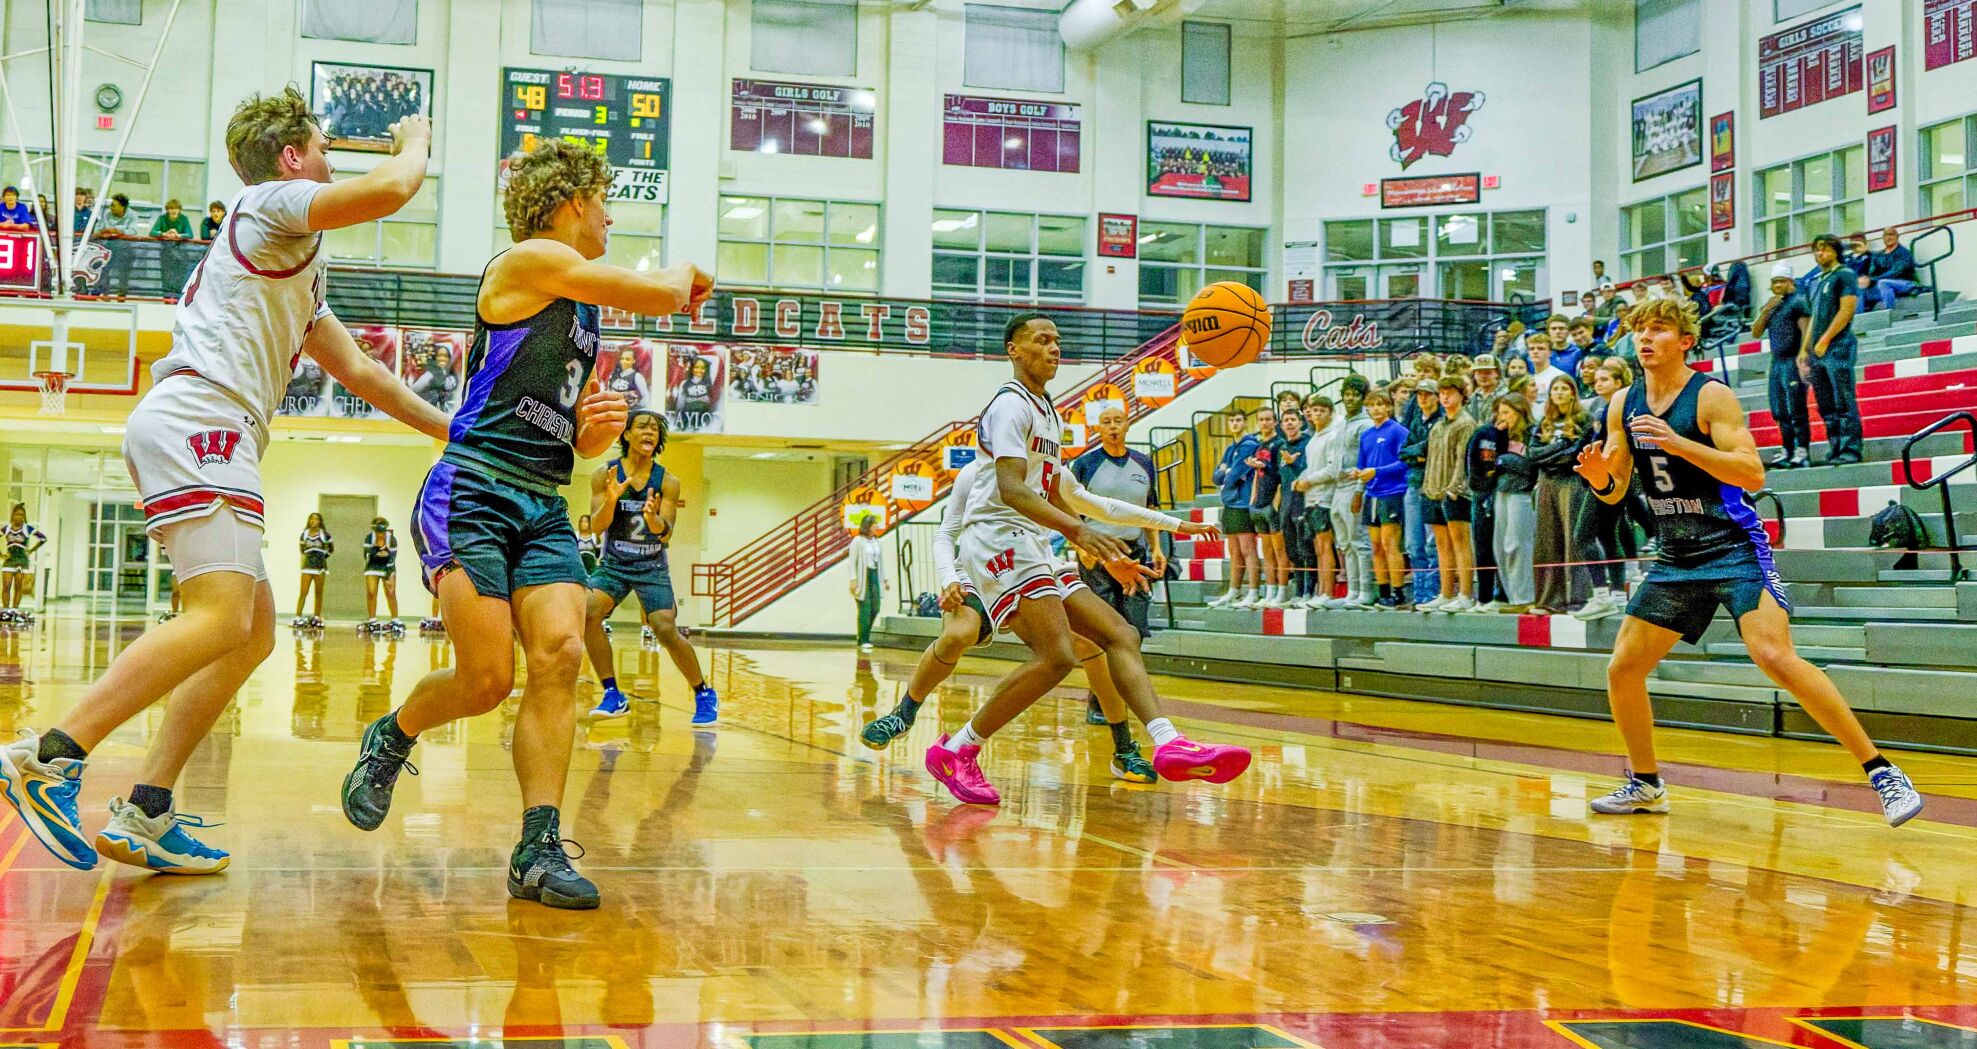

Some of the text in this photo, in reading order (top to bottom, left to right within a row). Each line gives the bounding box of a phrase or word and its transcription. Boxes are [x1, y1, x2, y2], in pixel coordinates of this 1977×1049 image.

[1778, 30, 1808, 49] GIRLS
[510, 71, 549, 84] GUEST
[626, 80, 662, 91] HOME
[517, 86, 546, 110] 48
[775, 87, 840, 101] GIRLS GOLF
[632, 93, 661, 118] 50
[988, 102, 1048, 116] BOYS GOLF
[594, 106, 608, 125] 3
[644, 141, 651, 159] 1
[632, 170, 664, 184] THE
[1302, 309, 1383, 352] Cats
[559, 358, 583, 408] 3
[279, 395, 329, 414] UROR
[1649, 455, 1675, 493] 5
[630, 515, 646, 541] 2
